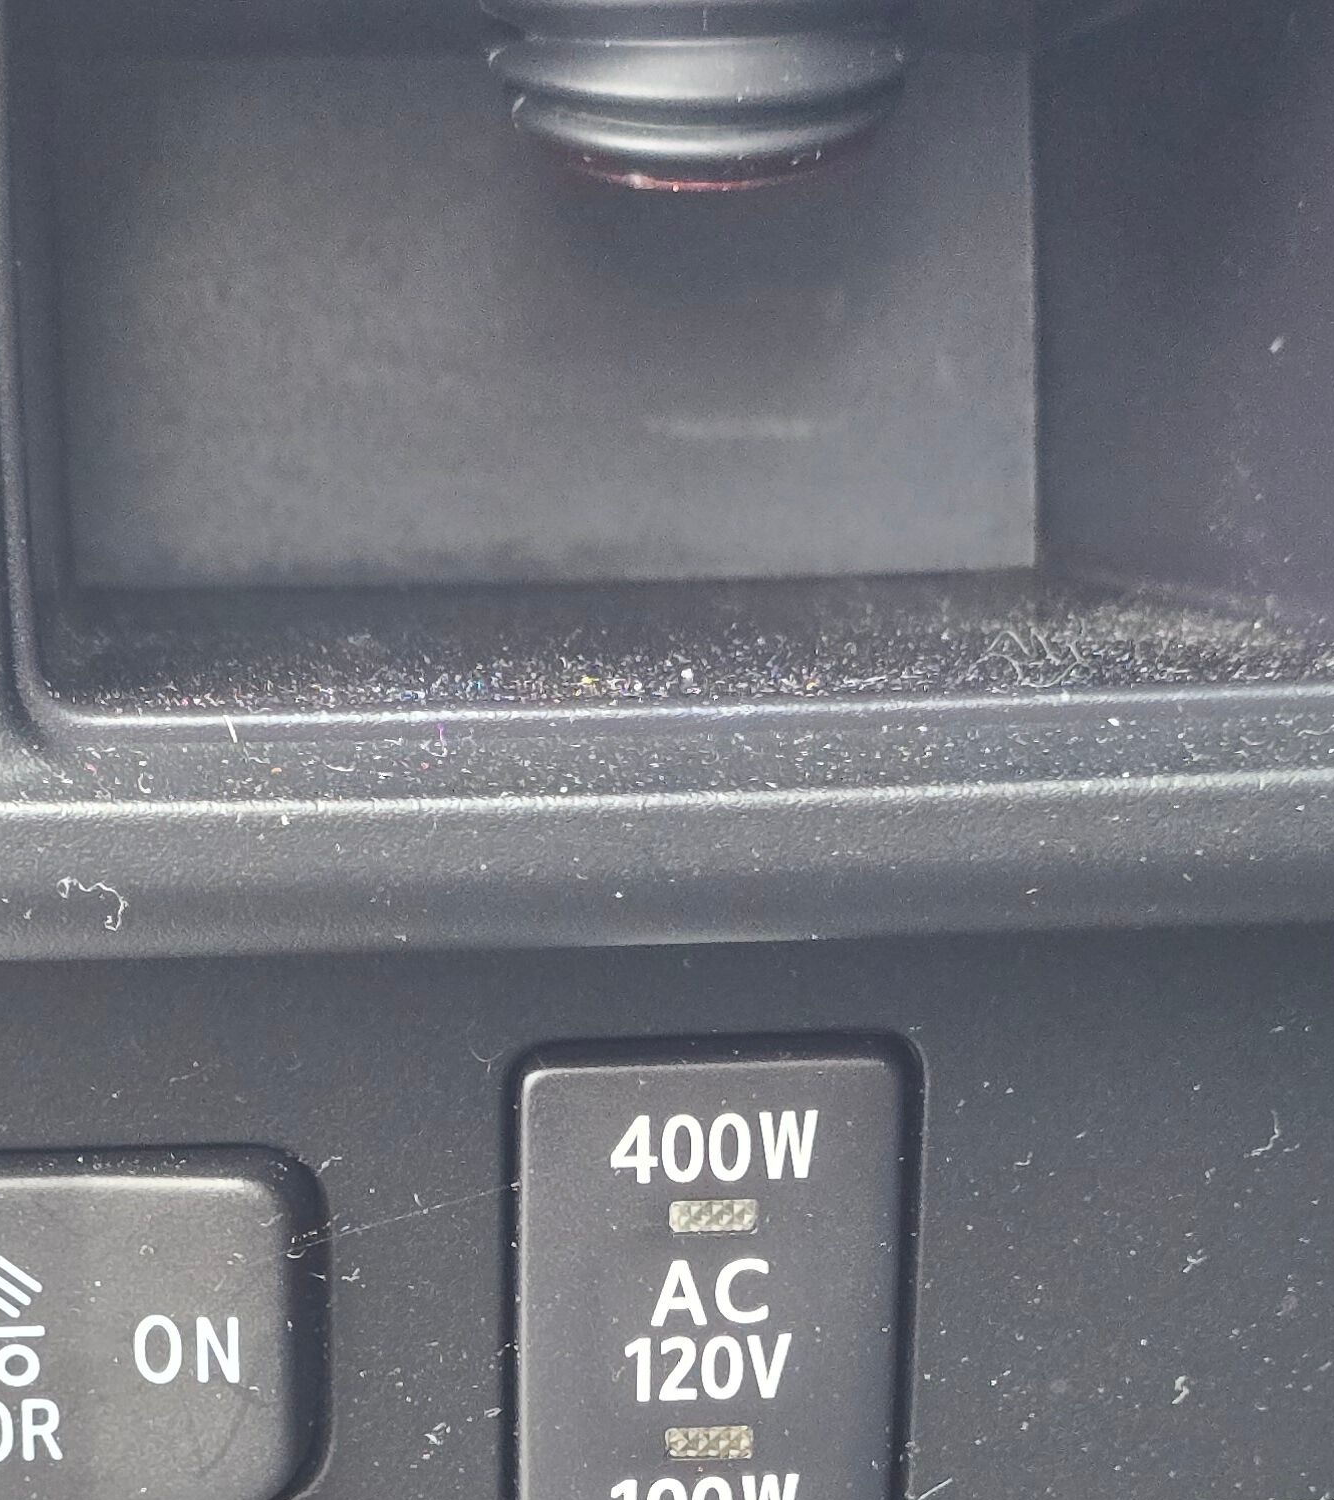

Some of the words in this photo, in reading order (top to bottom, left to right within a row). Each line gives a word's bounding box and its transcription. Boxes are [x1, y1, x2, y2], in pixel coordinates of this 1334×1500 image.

[610, 1109, 819, 1185] 400W
[650, 1257, 770, 1327] AC
[133, 1314, 241, 1385] ON
[624, 1332, 792, 1403] 120V
